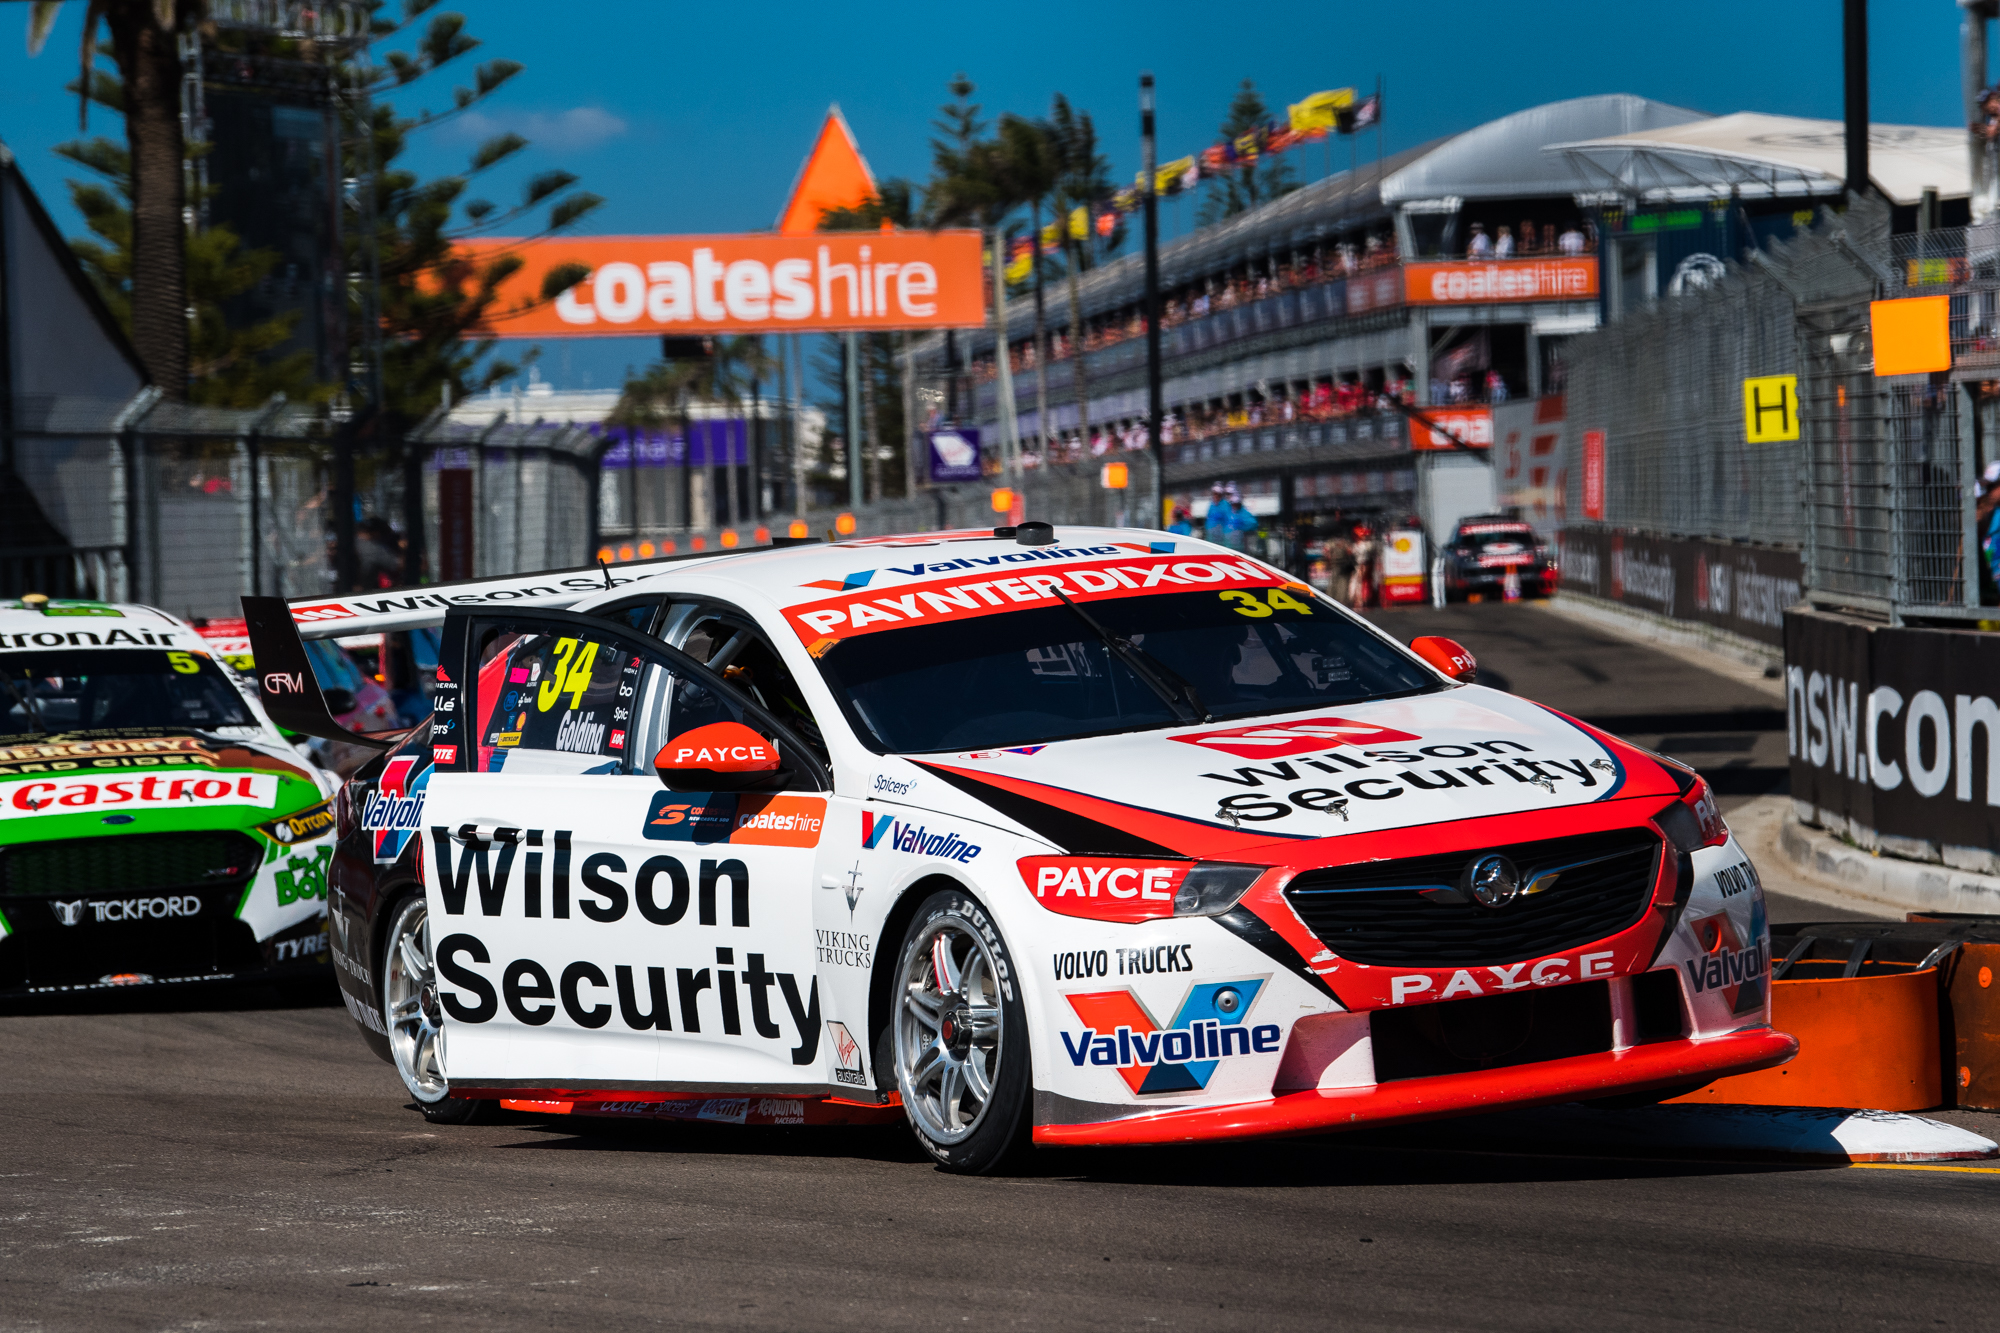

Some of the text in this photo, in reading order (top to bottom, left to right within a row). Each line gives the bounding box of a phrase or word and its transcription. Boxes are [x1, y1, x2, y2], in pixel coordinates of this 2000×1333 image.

[1754, 386, 1789, 435] H
[885, 545, 1121, 576] Valvoline
[352, 585, 562, 613] Wilson
[797, 561, 1272, 635] PAYNTER DIXON
[1219, 589, 1313, 618] 34
[0, 628, 176, 649] tronAir
[166, 651, 200, 674] 5
[537, 636, 600, 712] 34
[556, 709, 605, 755] Golding
[675, 746, 766, 763] PAYCE
[1199, 740, 1533, 787] Wilson
[12, 776, 258, 810] Castrol
[873, 774, 910, 795] Spicers
[1217, 757, 1600, 822] Security
[363, 792, 426, 828] Valvoli
[739, 812, 820, 832] coateshire
[894, 821, 982, 864] Valvoline
[431, 826, 750, 927] Wilson
[1036, 866, 1174, 901] PAYCE
[88, 895, 202, 922] TICKFORD
[816, 929, 870, 951] VIKING
[961, 900, 1014, 1002] DUNLOP
[817, 947, 871, 969] TRUCKS
[1054, 944, 1193, 980] VOLVO TRUCKS
[1391, 951, 1614, 1005] PAYCE
[435, 934, 821, 1065] Security
[1060, 1021, 1281, 1067] Valvoline
[837, 1070, 866, 1085] australia
